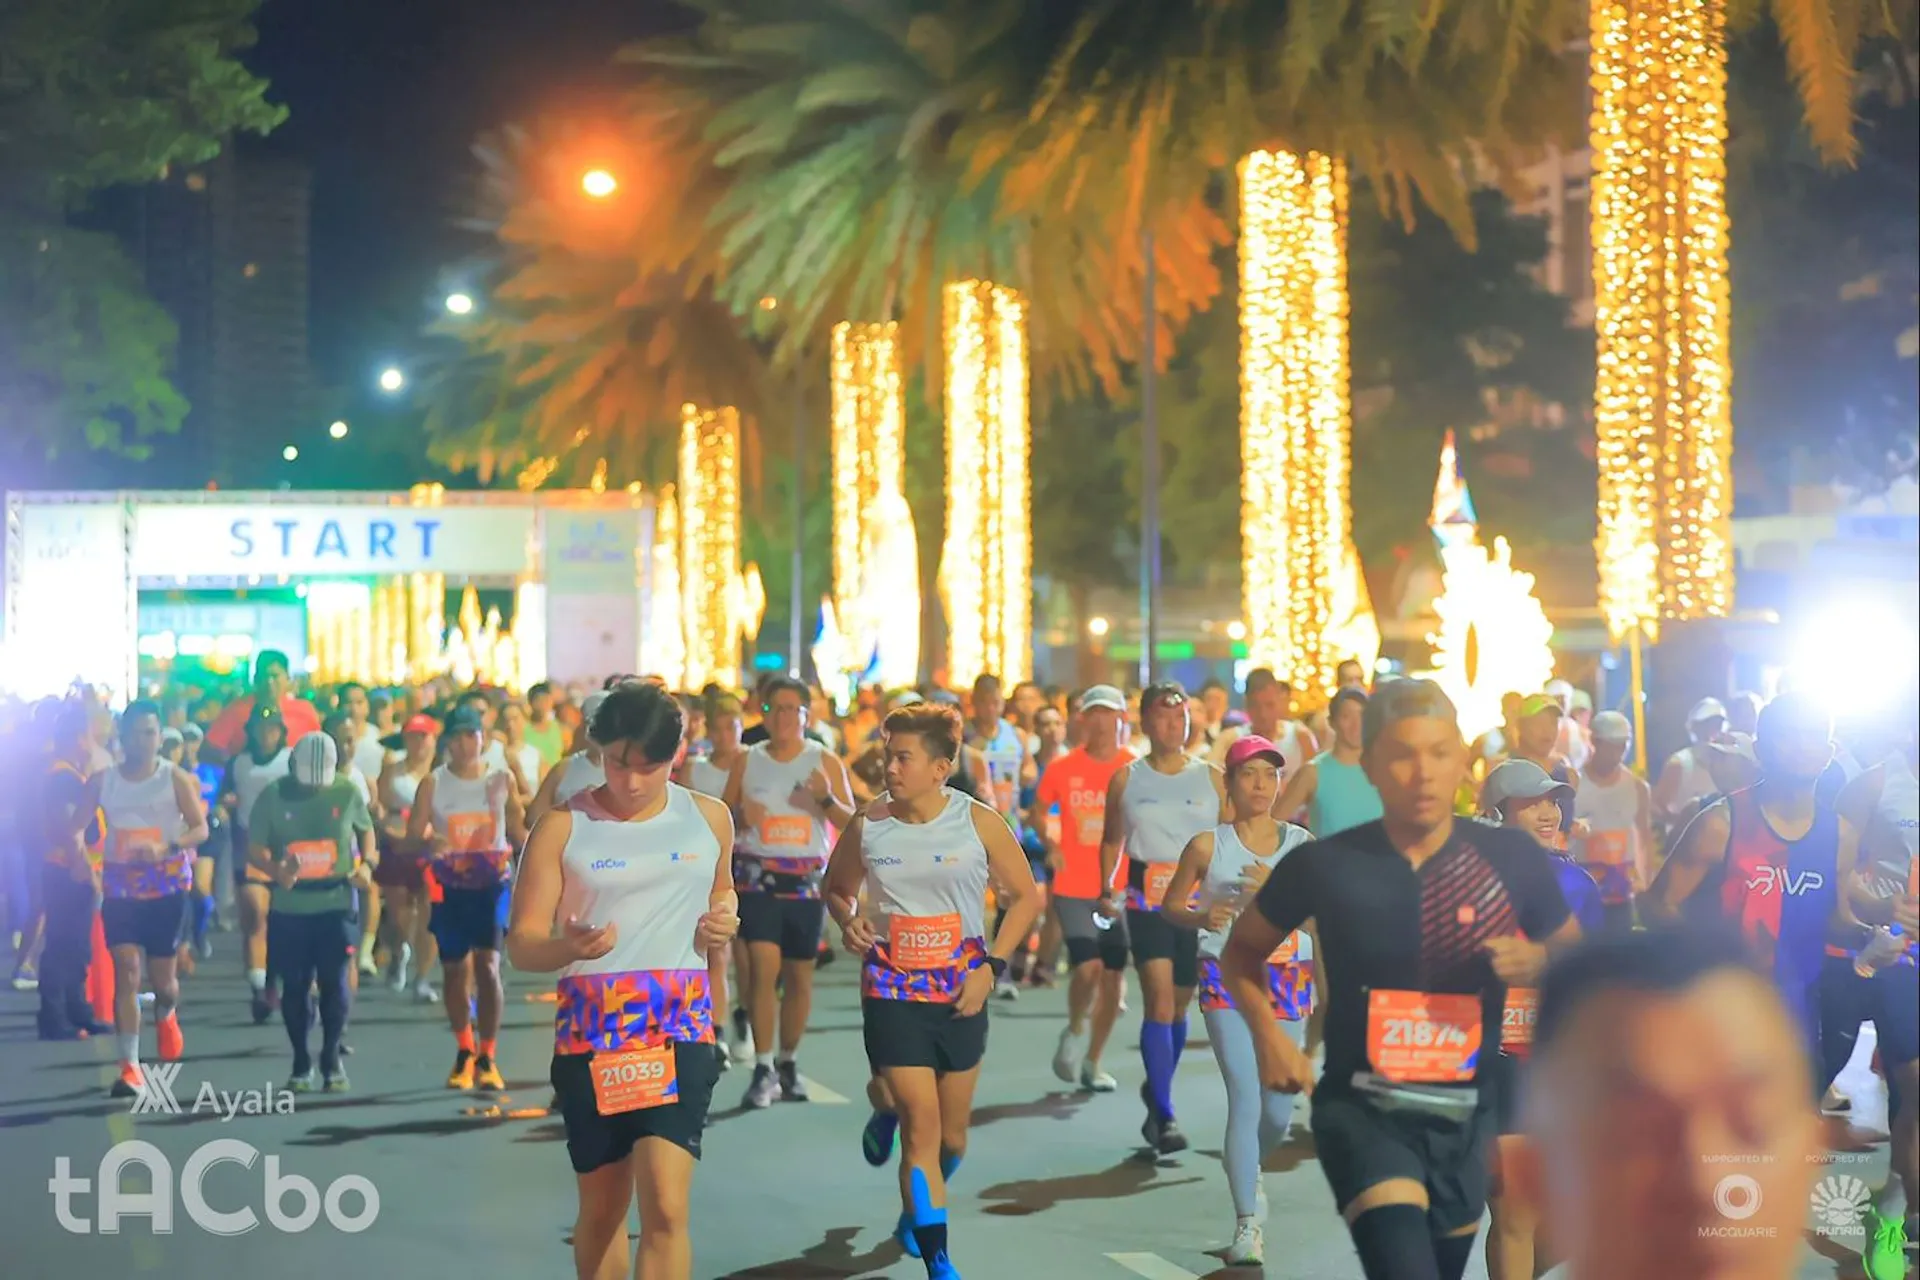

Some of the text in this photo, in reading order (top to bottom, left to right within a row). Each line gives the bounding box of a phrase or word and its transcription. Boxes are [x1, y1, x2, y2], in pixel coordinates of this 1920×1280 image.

[230, 519, 442, 558] START
[898, 931, 952, 949] 21922
[1382, 1019, 1468, 1048] 21874
[600, 1061, 666, 1088] 21039
